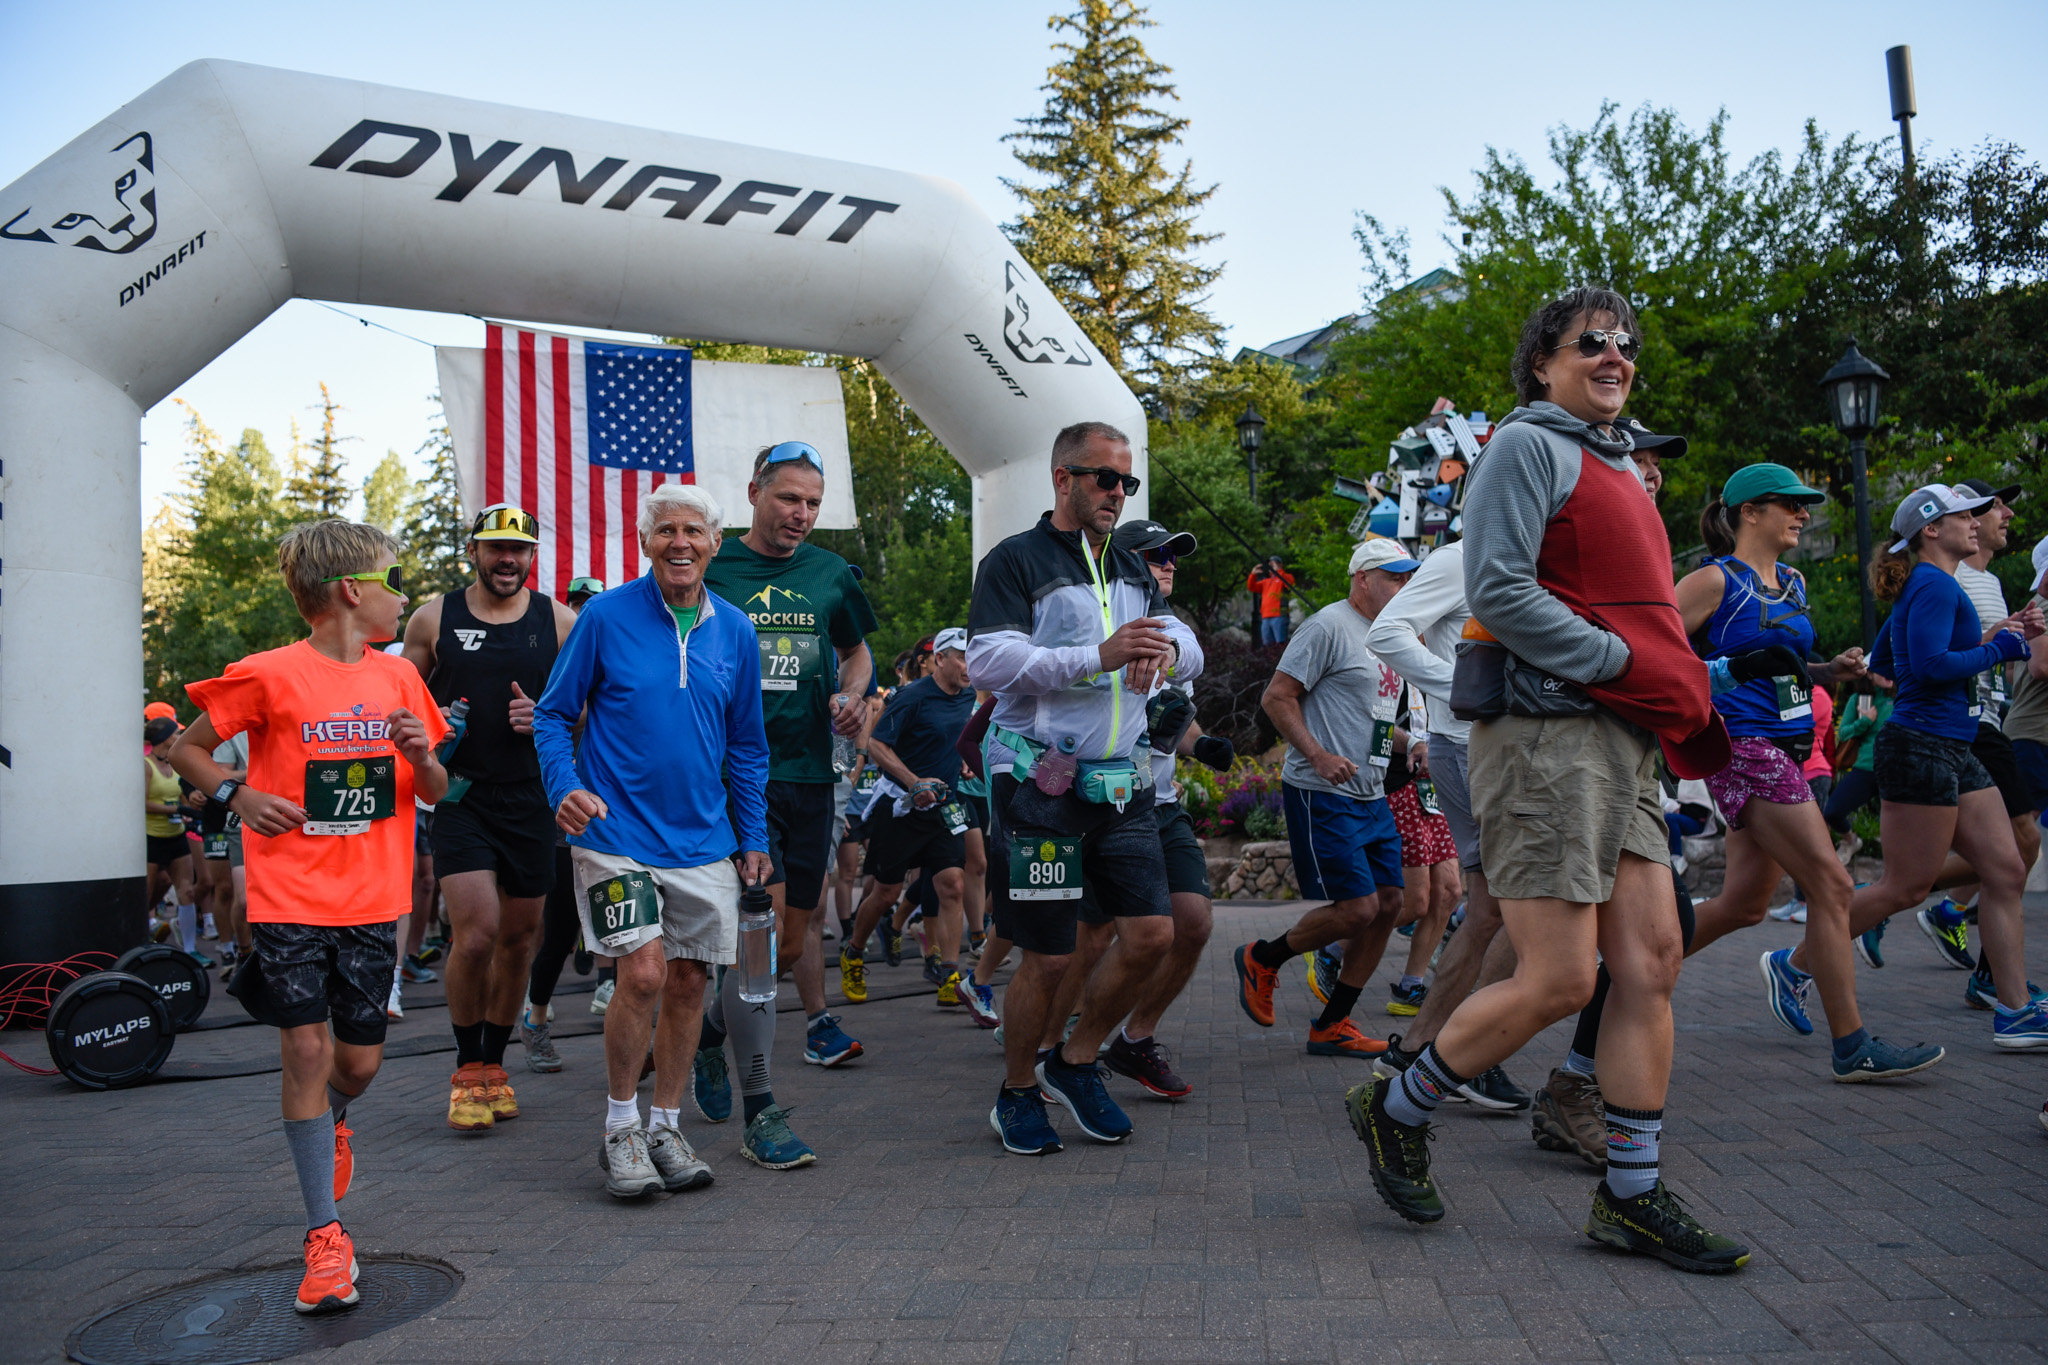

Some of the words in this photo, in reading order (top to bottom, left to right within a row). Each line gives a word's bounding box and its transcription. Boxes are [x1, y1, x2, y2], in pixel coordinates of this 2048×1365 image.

[309, 118, 901, 244] DYNAFIT
[119, 230, 207, 307] DYNAFIT
[964, 333, 1028, 398] DYNAFIT
[748, 612, 815, 626] ROCKIES
[768, 655, 800, 676] 723
[333, 787, 376, 816] 725
[1029, 862, 1066, 885] 890
[605, 899, 636, 930] 877
[155, 981, 191, 995] LAPS
[74, 1016, 151, 1048] MYLAPS
[102, 1036, 129, 1048] EASYMAT
